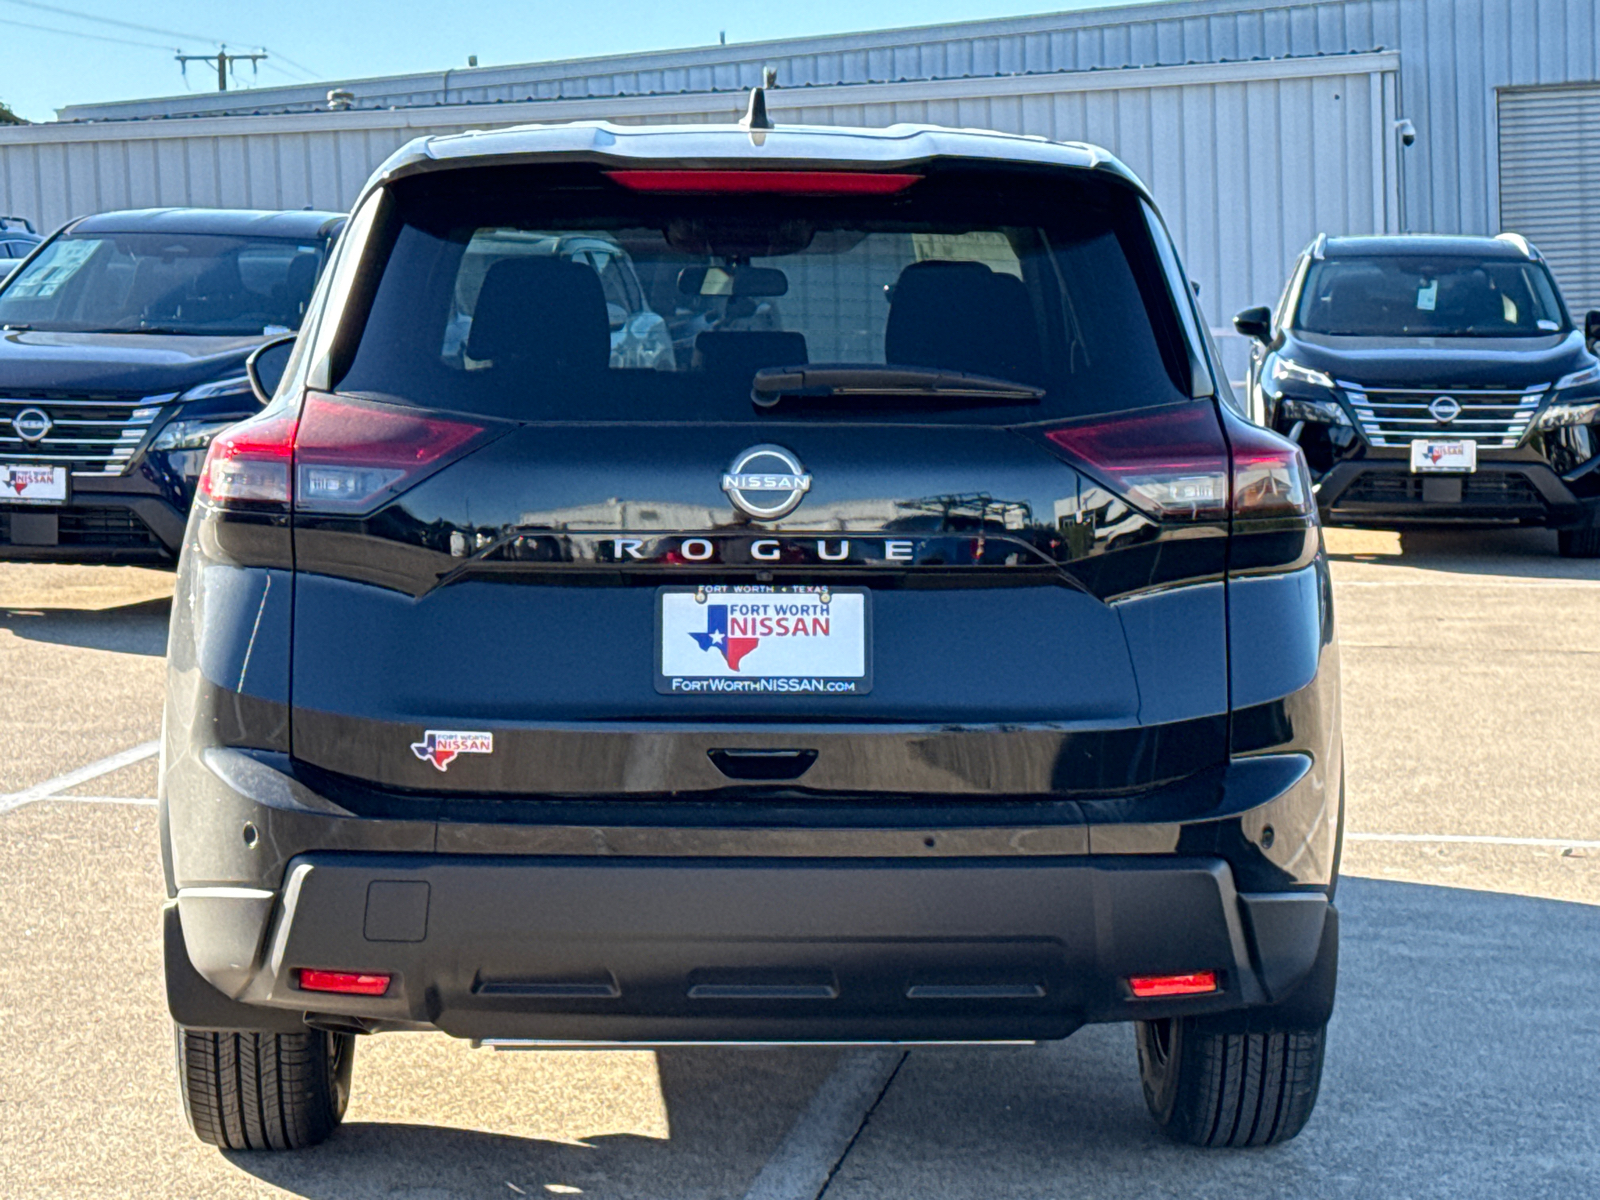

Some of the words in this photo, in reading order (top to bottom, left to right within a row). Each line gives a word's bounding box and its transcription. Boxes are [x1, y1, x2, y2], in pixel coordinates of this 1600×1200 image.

[17, 475, 54, 484] NISSAN
[725, 475, 808, 489] NISSAN
[613, 538, 914, 561] ROGUE
[698, 585, 728, 593] FORT
[734, 585, 775, 593] WORTH
[792, 585, 829, 593] TEXAS
[730, 604, 771, 616] FORT
[775, 604, 830, 616] WORTH
[730, 617, 830, 637] NISSAN
[437, 740, 490, 750] NISSAN
